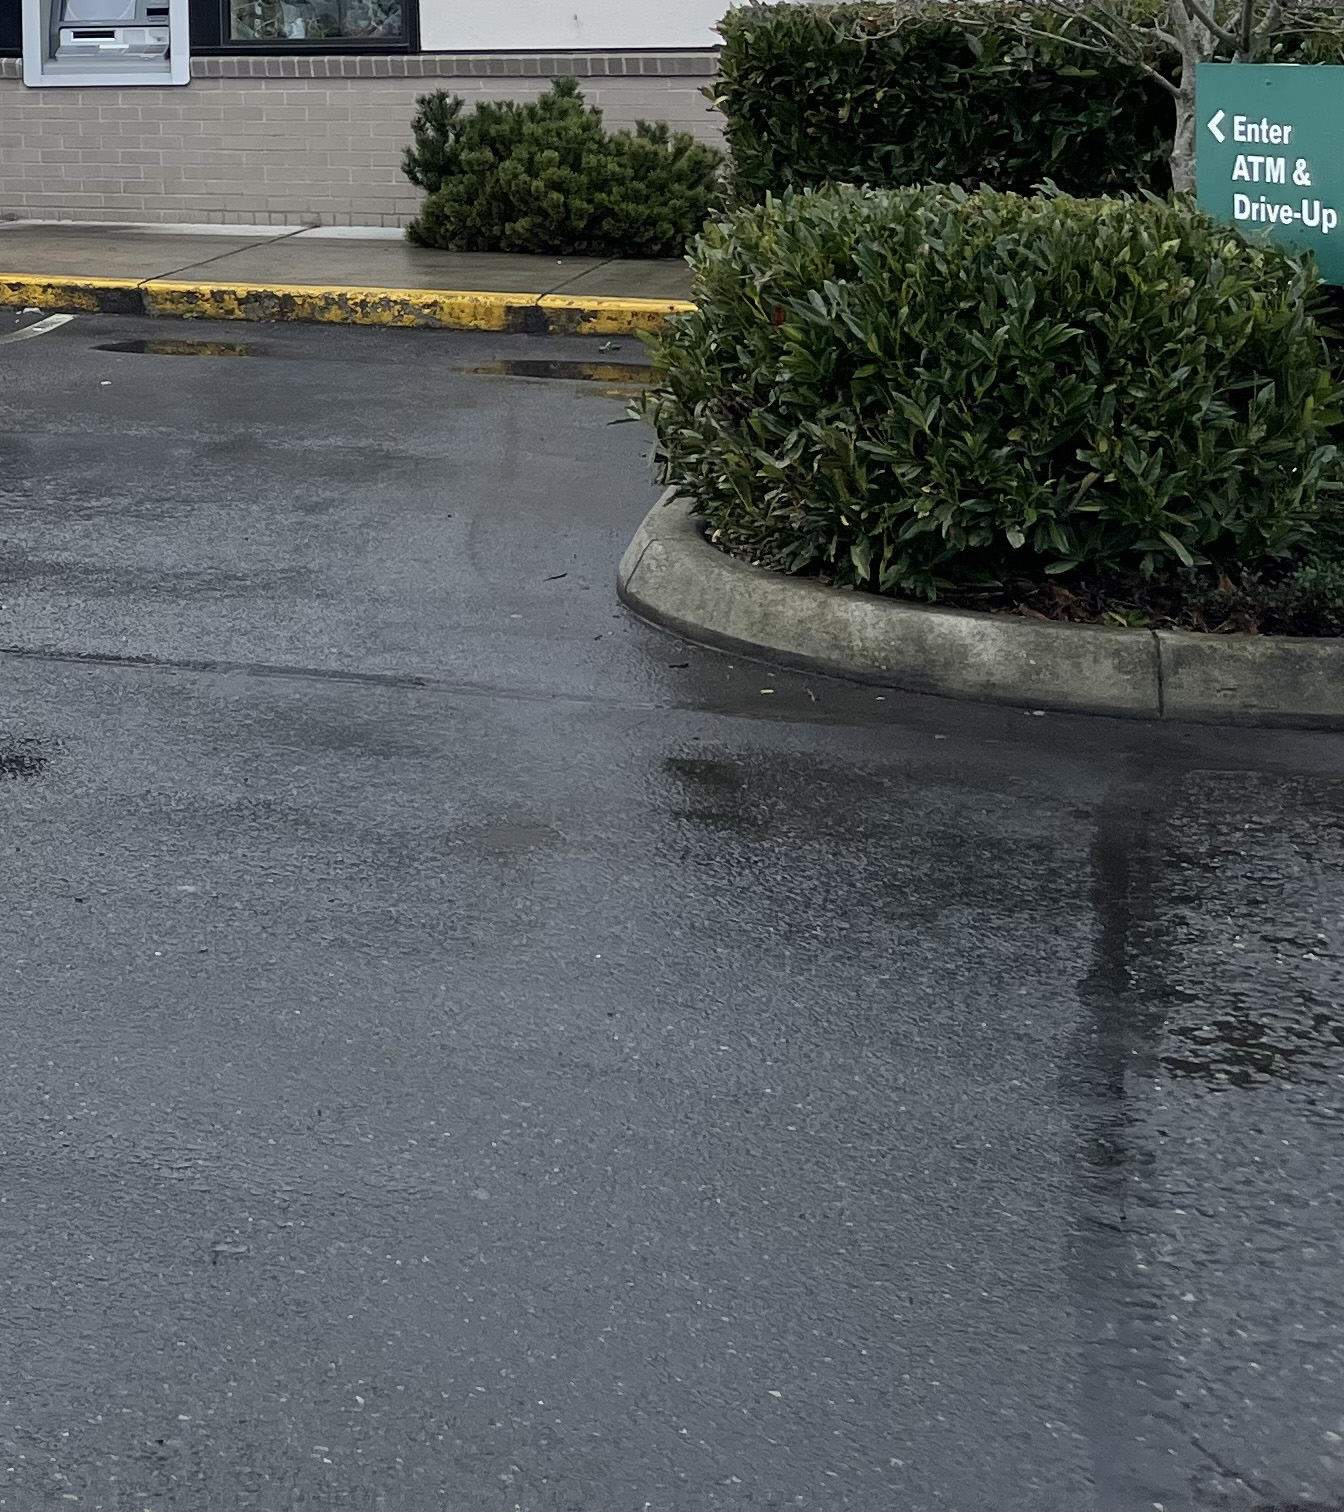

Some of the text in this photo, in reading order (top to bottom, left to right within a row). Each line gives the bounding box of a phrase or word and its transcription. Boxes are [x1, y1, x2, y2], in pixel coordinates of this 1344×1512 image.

[1233, 115, 1292, 145] Enter
[1232, 154, 1312, 186] ATM &
[1233, 193, 1338, 234] Drive-Up
